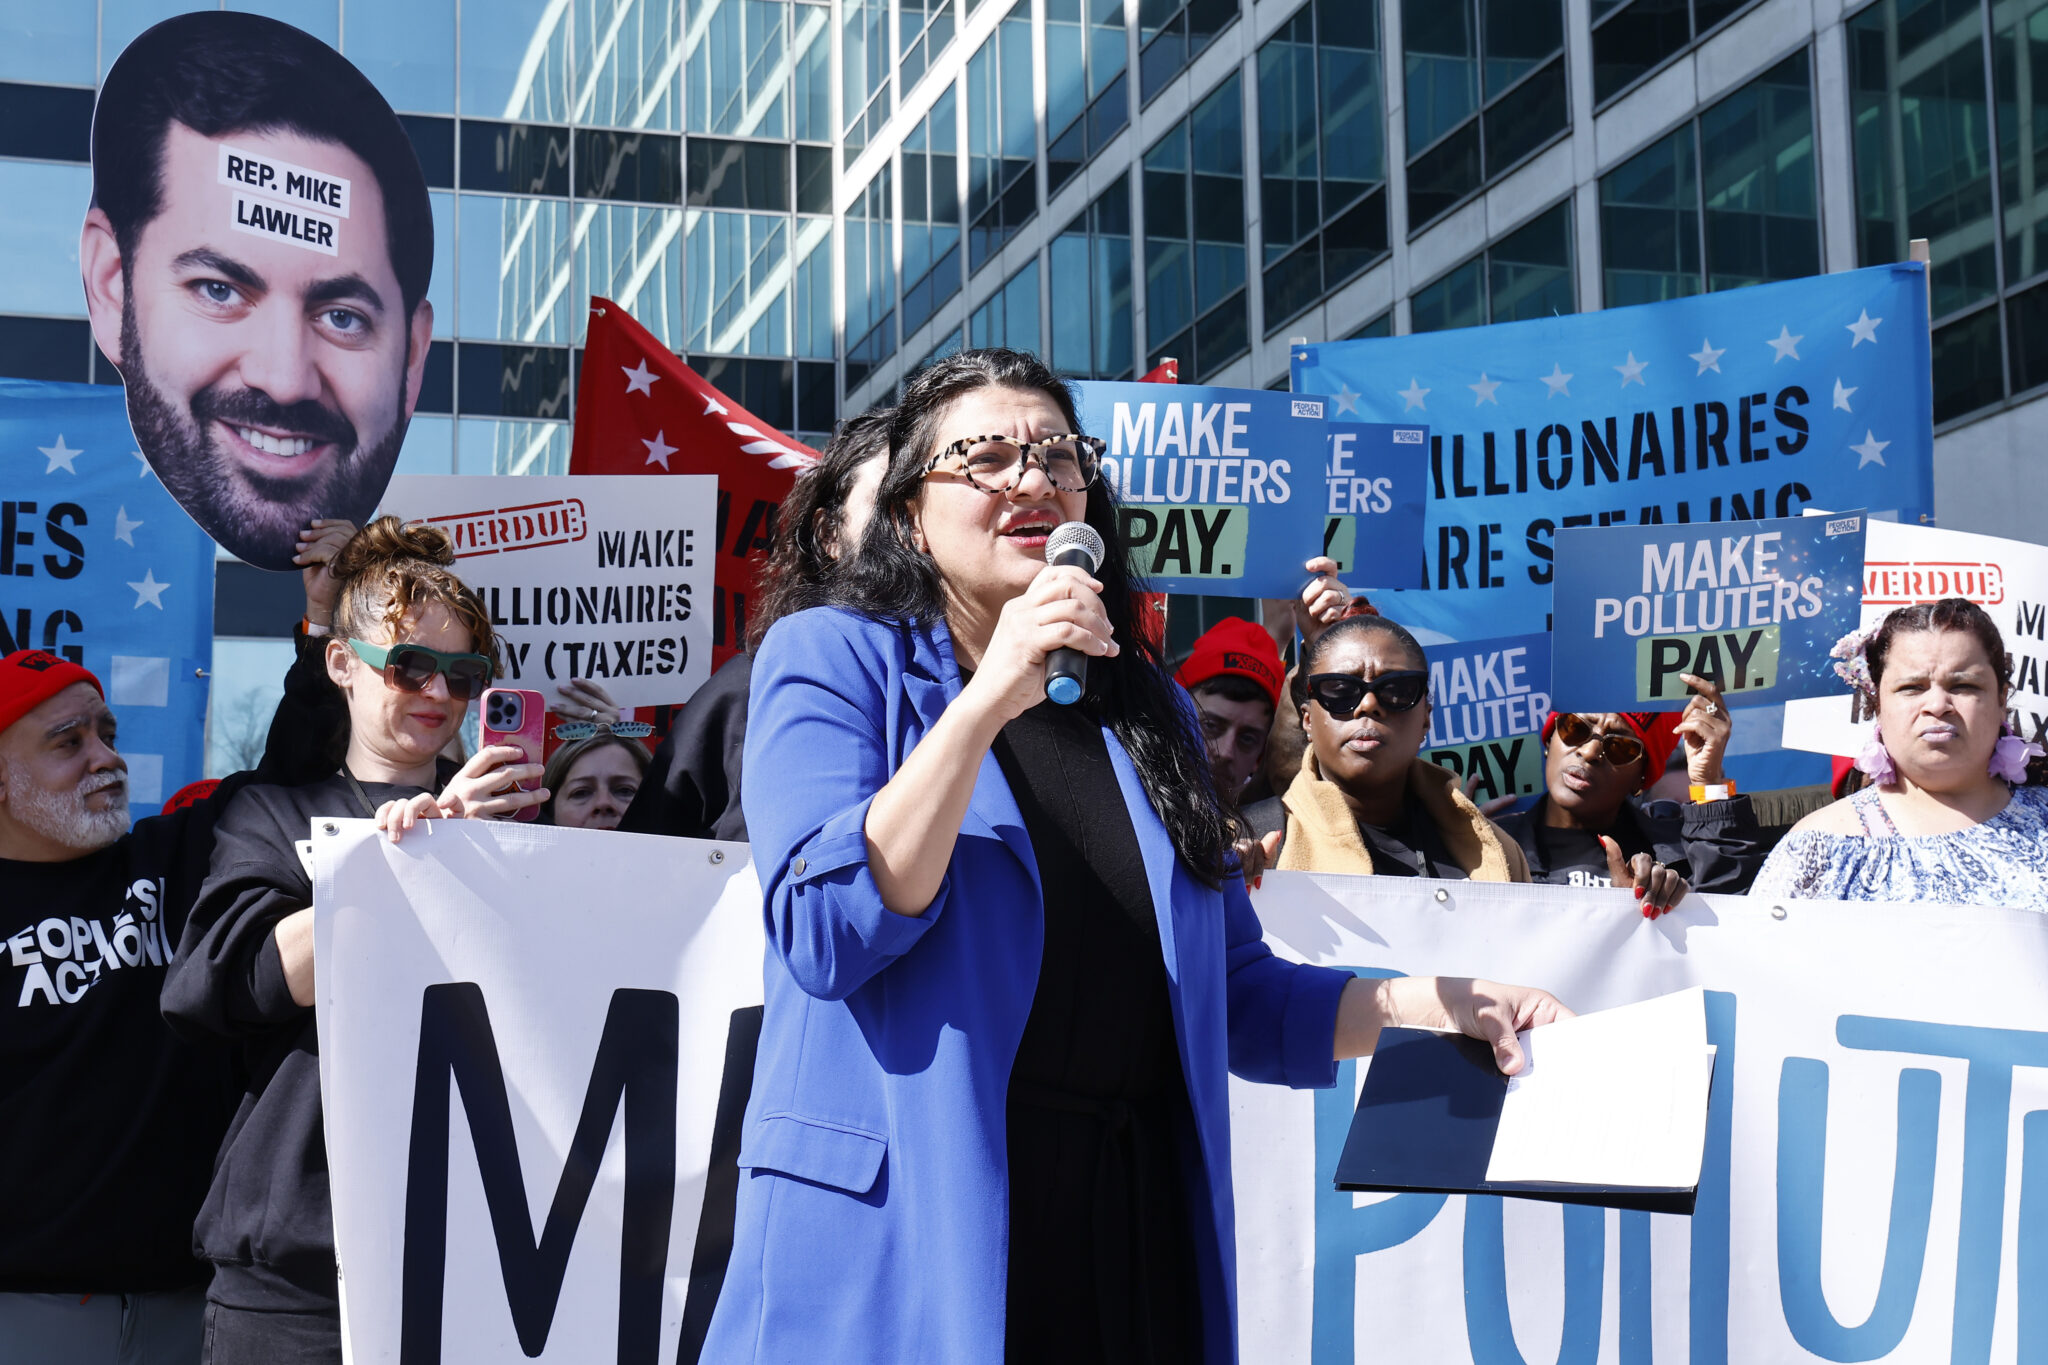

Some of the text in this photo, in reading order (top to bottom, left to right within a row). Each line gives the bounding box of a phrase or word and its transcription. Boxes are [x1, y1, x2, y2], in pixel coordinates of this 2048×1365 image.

[227, 154, 341, 208] REP. MIKE
[237, 199, 333, 247] LAWLER
[1111, 402, 1251, 457] MAKE
[1294, 403, 1319, 411] PEOPLE'S
[1430, 385, 1811, 500] ILLIONAIRES
[1099, 458, 1291, 504] OLLUTERS
[441, 508, 579, 550] VERDUE
[598, 529, 694, 568] MAKE
[1120, 508, 1232, 574] PAY.
[1395, 523, 1505, 592] RE
[1642, 531, 1782, 594] MAKE
[1862, 571, 1997, 596] VERDUE
[1594, 577, 1824, 638] POLLUTERS
[544, 635, 688, 680] (TAXES)
[1427, 647, 1531, 706] MAKE
[1650, 629, 1764, 698] PAY.
